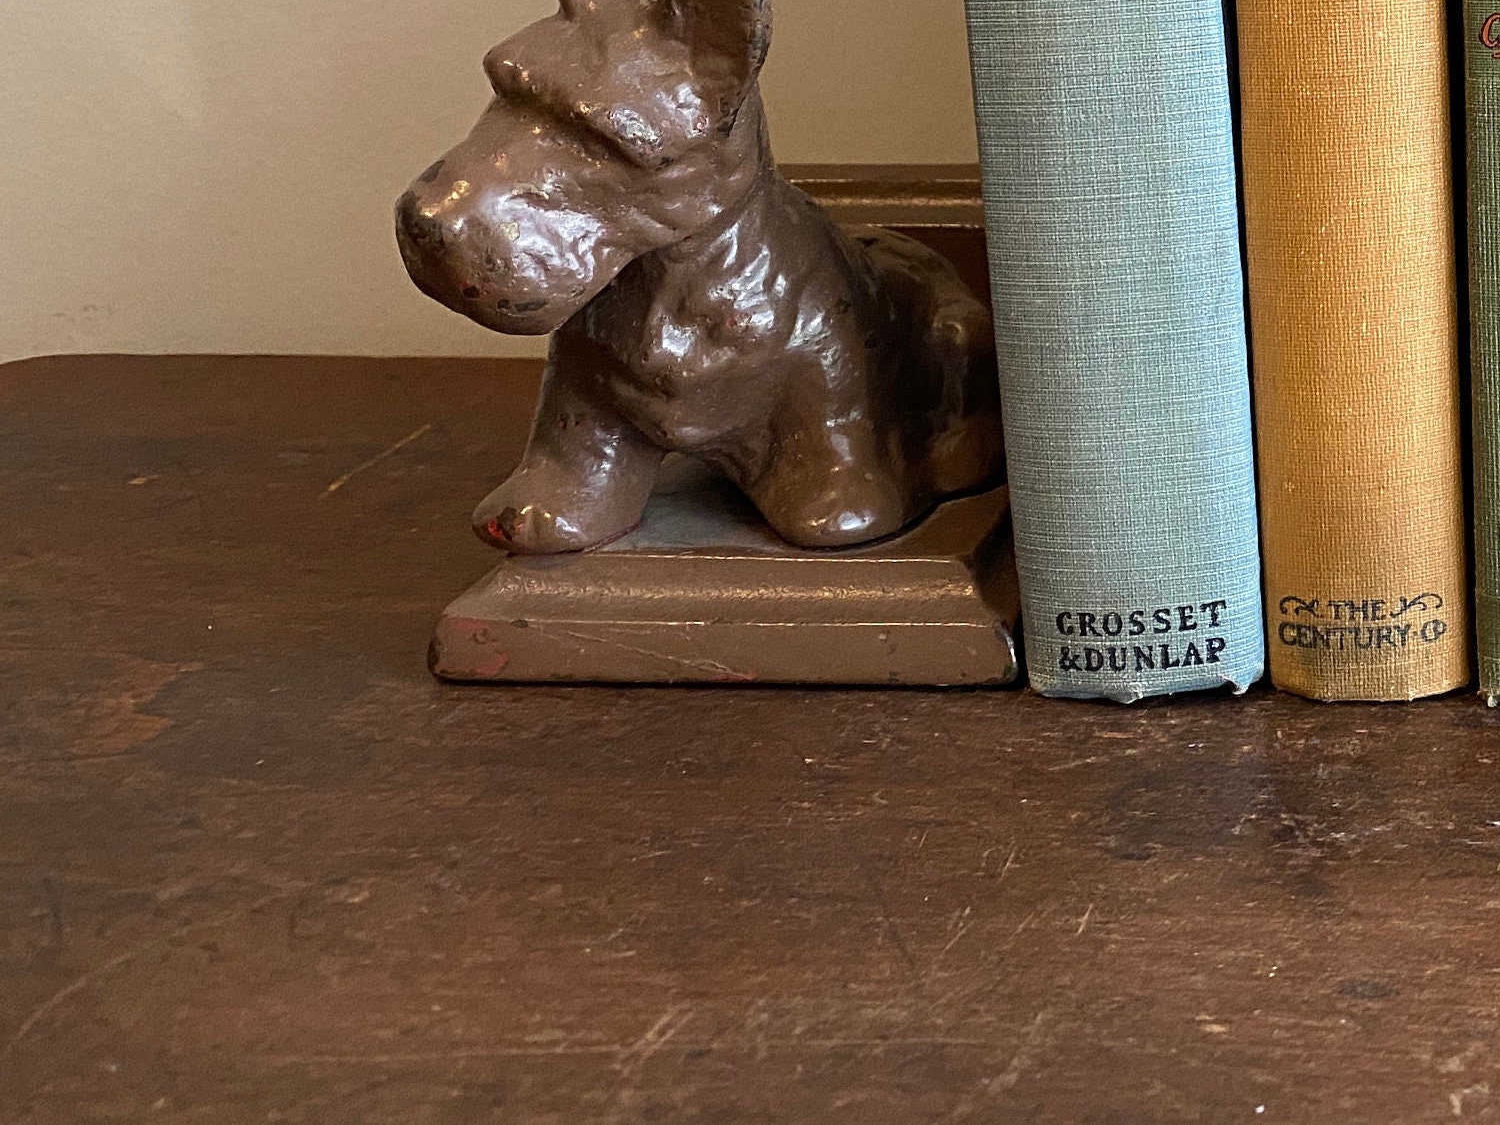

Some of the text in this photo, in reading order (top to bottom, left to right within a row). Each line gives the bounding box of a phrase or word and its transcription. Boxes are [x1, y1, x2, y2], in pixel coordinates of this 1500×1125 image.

[1055, 599, 1227, 637] GROSSET
[1327, 599, 1387, 622] THE
[1278, 621, 1412, 650] CENTURY
